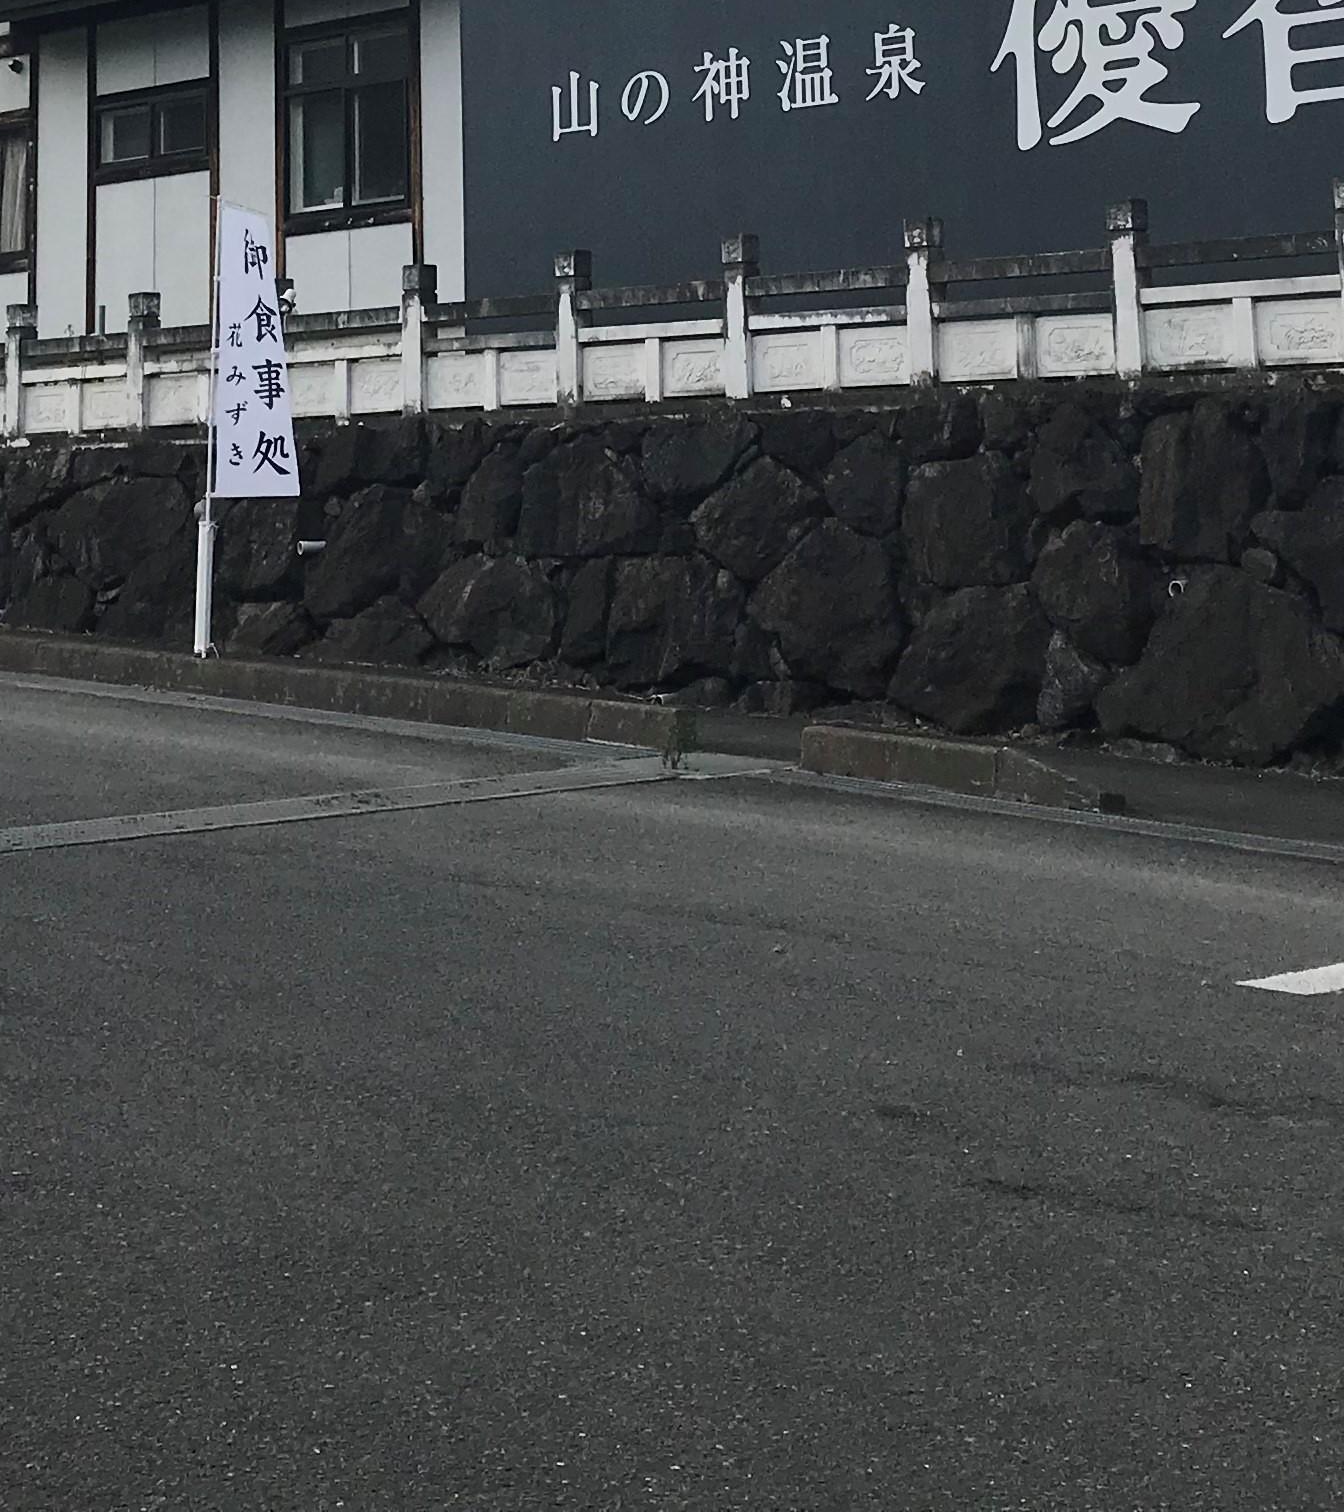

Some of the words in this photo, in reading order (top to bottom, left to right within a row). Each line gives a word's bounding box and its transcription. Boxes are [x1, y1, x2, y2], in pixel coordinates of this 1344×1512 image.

[551, 23, 926, 142] 山の神温泉
[225, 322, 247, 466] 花みずき
[244, 228, 291, 476] 御食事処
